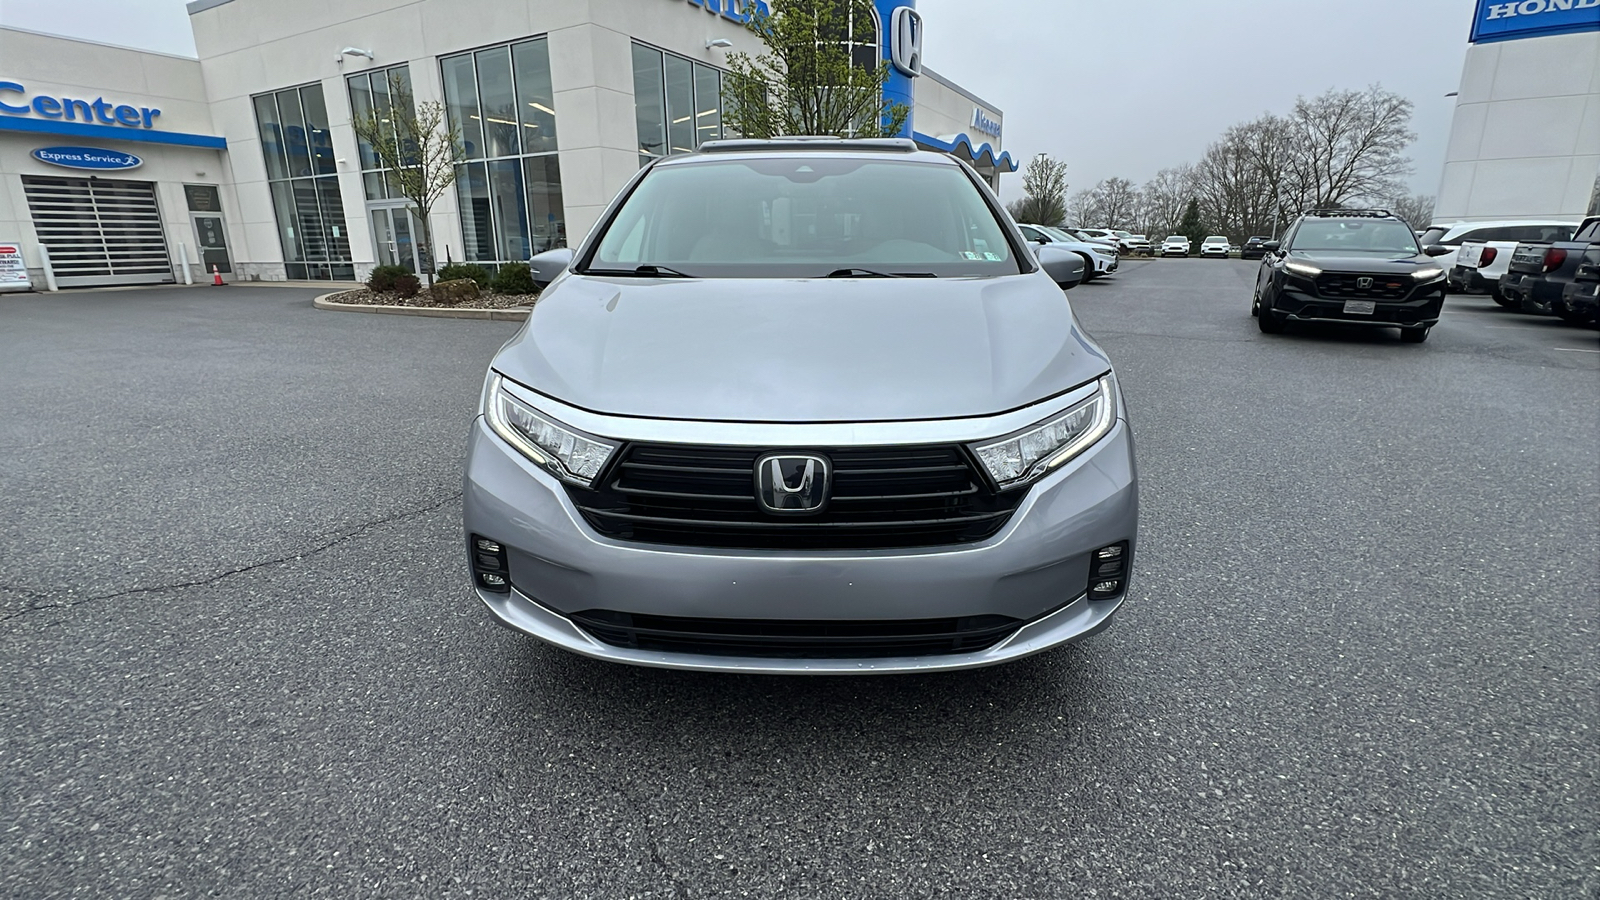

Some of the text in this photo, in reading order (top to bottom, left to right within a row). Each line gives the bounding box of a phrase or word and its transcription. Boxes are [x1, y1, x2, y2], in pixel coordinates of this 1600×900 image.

[0, 81, 161, 129] Center
[40, 151, 122, 164] Express Service
